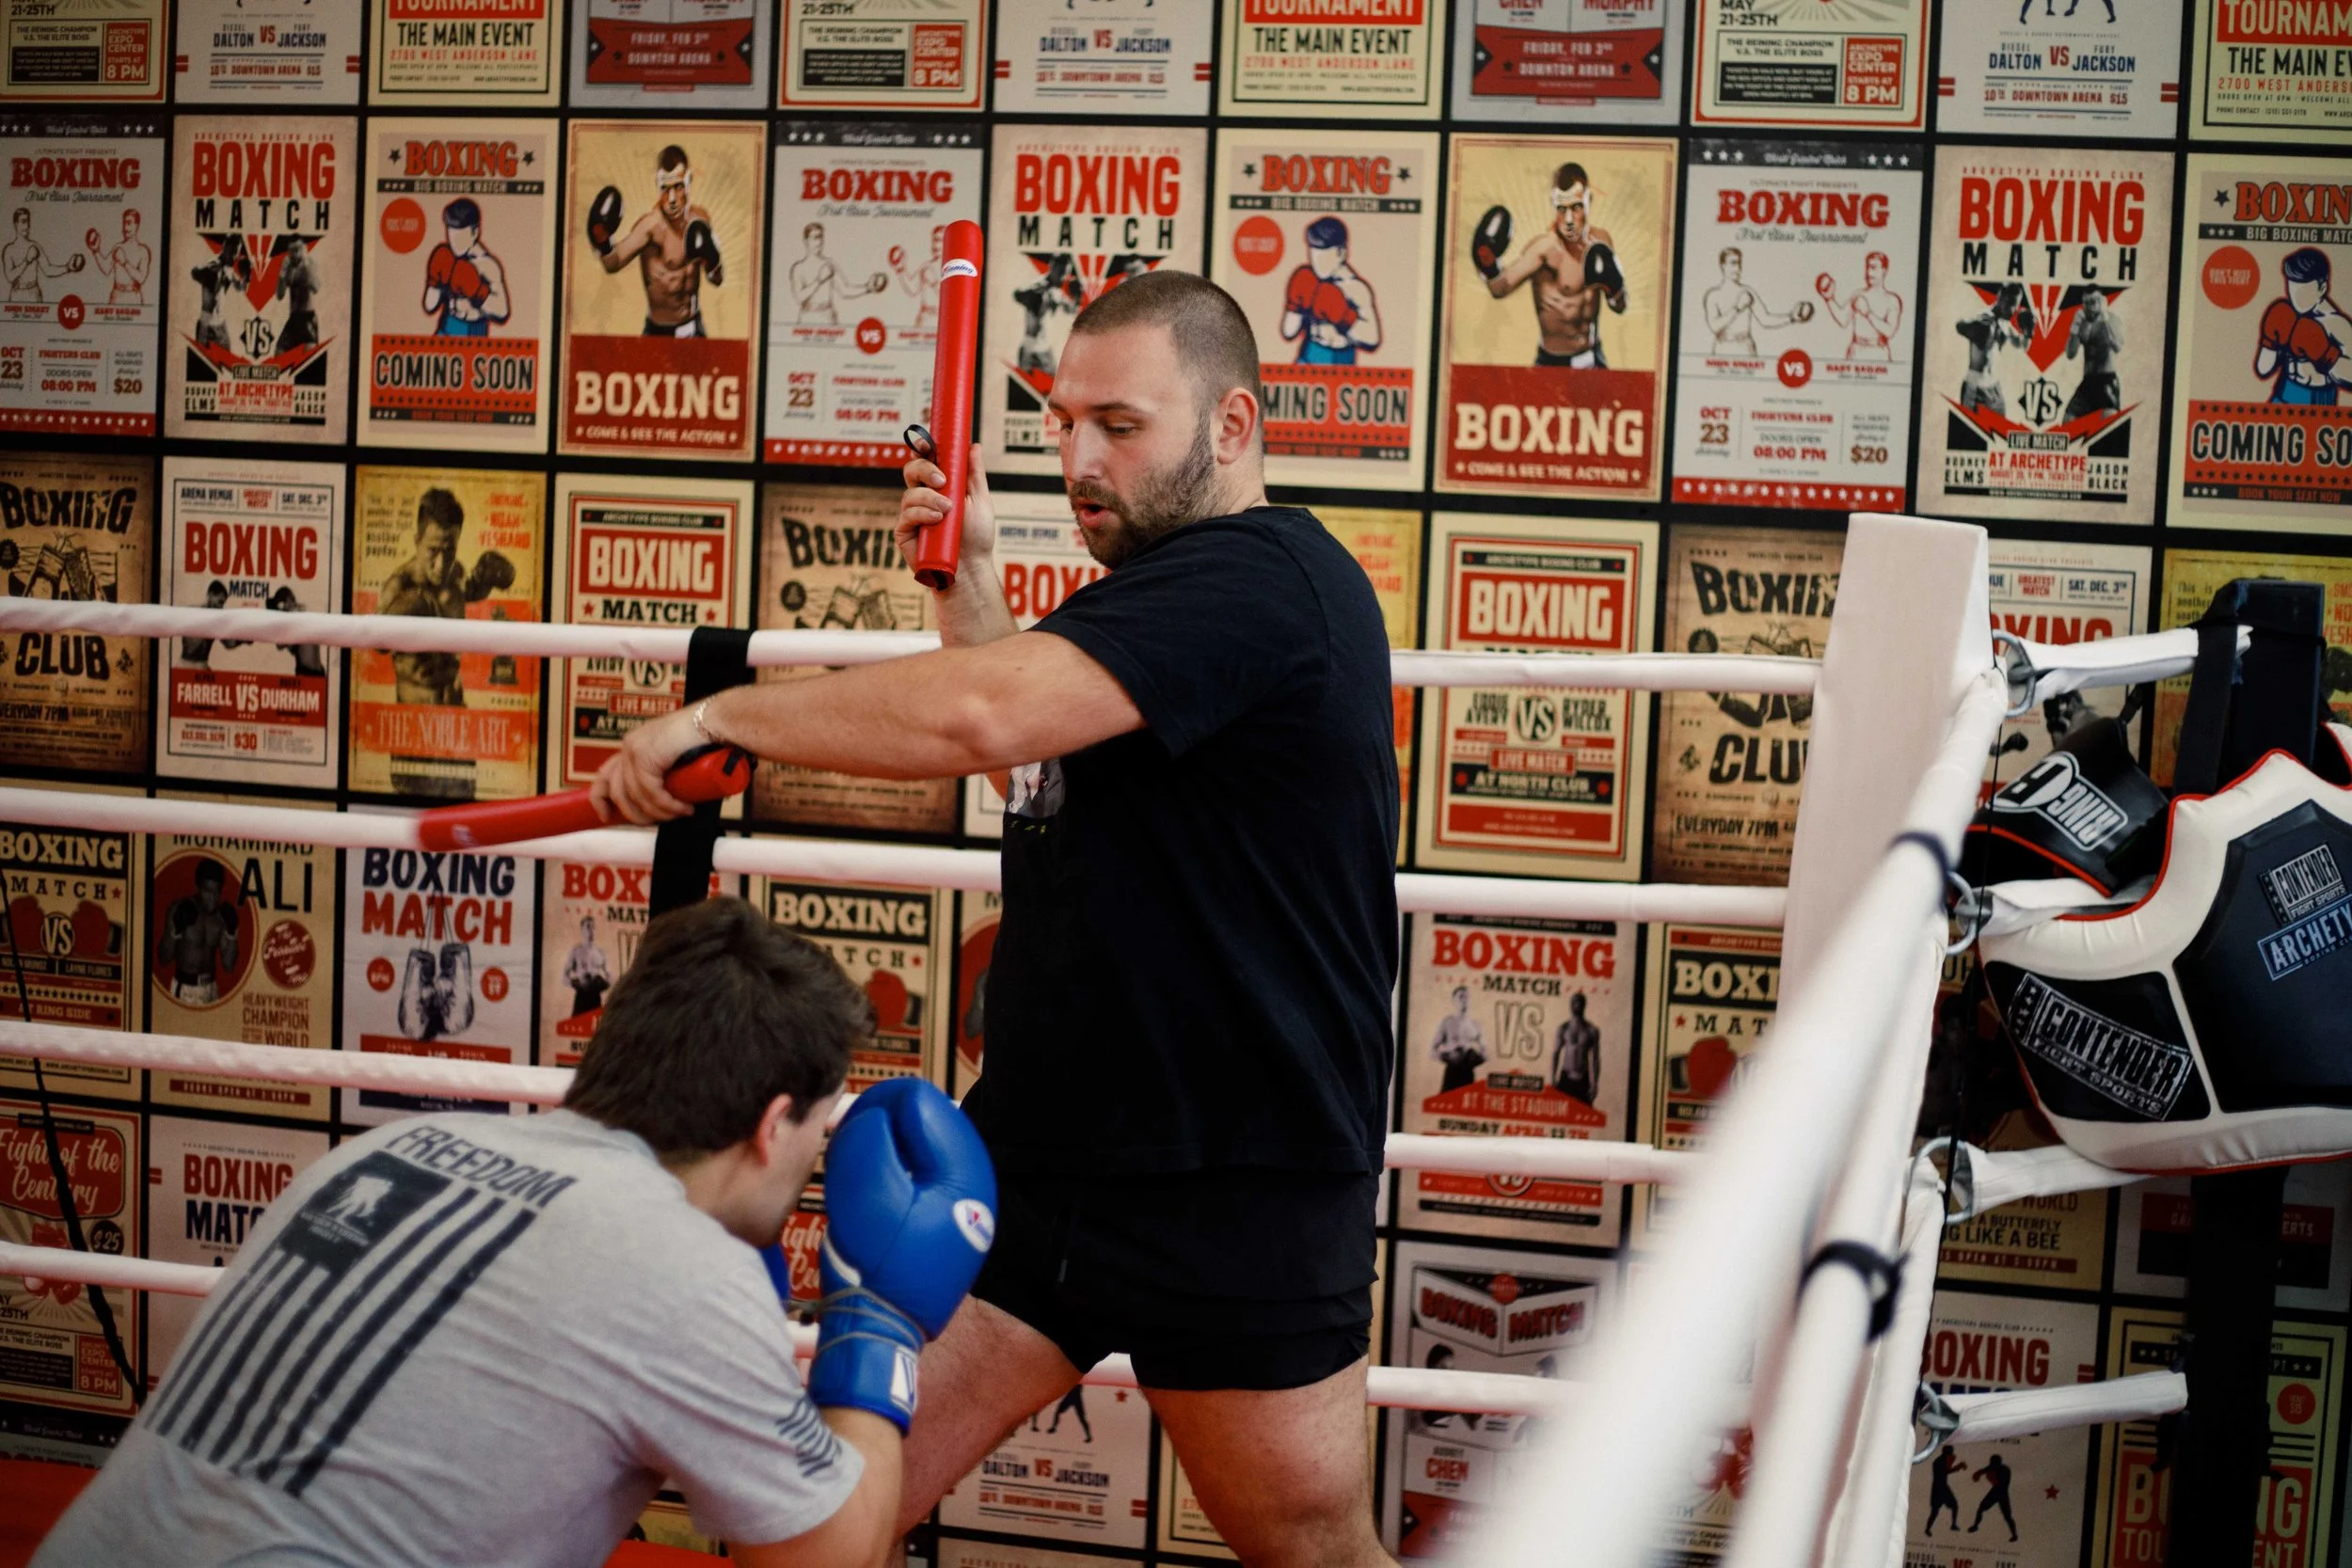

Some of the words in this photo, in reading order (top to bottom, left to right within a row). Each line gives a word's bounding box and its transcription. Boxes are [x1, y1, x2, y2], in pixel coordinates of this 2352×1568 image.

[1720, 0, 1755, 12] MAY
[1720, 12, 1778, 26] 21-25TH
[2224, 0, 2352, 36] TOURNAM
[213, 32, 254, 47] DALTON
[260, 24, 276, 43] VS
[278, 32, 326, 48] JACKSON
[398, 23, 430, 46] THE
[433, 23, 477, 47] MAIN
[481, 23, 534, 47] EVENT
[1253, 28, 1288, 53] THE
[1295, 28, 1344, 54] MAIN
[1351, 29, 1411, 55] EVENT
[1848, 61, 1897, 73] CENTER
[1849, 52, 1883, 62] EXPO
[1989, 53, 2042, 70] DALTON
[2049, 45, 2070, 67] VS
[2073, 55, 2136, 72] JACKSON
[2228, 47, 2266, 74] THE
[2273, 48, 2328, 77] MAIN
[1846, 86, 1859, 101] 8
[1865, 87, 1897, 103] PM
[2011, 90, 2069, 103] DOWNTOWN
[2072, 91, 2103, 103] ARENA
[2217, 77, 2250, 90] 2700
[2257, 78, 2291, 91] WEST
[2297, 79, 2352, 94] ANDERS
[192, 141, 336, 199] BOXING
[405, 138, 518, 178] BOXING
[11, 157, 140, 189] BOXING
[802, 169, 954, 204] BOXING
[1015, 153, 1181, 216] BOXING
[1261, 154, 1392, 196] BOXING
[196, 199, 330, 230] MATCH
[1716, 189, 1890, 229] BOXING
[1959, 177, 2145, 245] BOXING
[2233, 181, 2352, 226] BOXIN
[1019, 215, 1175, 250] MATCH
[2247, 227, 2266, 241] BIG
[2273, 228, 2318, 242] BOXING
[2323, 229, 2352, 243] MATC
[1963, 242, 2137, 282] MATCH
[63, 307, 79, 319] VS
[245, 321, 272, 356] VS
[2, 361, 24, 379] 23
[375, 352, 463, 390] COMING
[472, 355, 535, 393] SOON
[1784, 361, 1805, 377] VS
[114, 379, 142, 394] $20
[218, 384, 232, 396] AT
[235, 384, 294, 400] ARCHETYPE
[574, 371, 740, 421] BOXING
[1263, 382, 1329, 422] MING
[1337, 383, 1410, 426] SOON
[1700, 406, 1731, 420] OCT
[2025, 380, 2060, 421] VS
[1454, 403, 1645, 458] BOXING
[1701, 423, 1730, 445] 23
[2010, 434, 2030, 448] LIVE
[2033, 435, 2068, 450] MATCH
[1754, 445, 1798, 460] 08:00
[1800, 447, 1827, 462] PM
[1851, 444, 1889, 466] $20
[2191, 420, 2306, 467] COMING
[2316, 425, 2352, 469] SO
[1468, 461, 1505, 475] COME
[1519, 463, 1543, 479] SEE
[1546, 464, 1573, 480] THE
[1989, 452, 2006, 467] AT
[2010, 453, 2087, 471] ARCHETYPE
[2088, 463, 2128, 475] JASON
[1946, 469, 1985, 485] ELMS
[2088, 478, 2128, 490] BLACK
[0, 481, 136, 534] BOXING
[2238, 487, 2265, 499] BOOK
[2296, 490, 2317, 502] SEAT
[2320, 491, 2342, 503] NOW
[184, 522, 318, 580] BOXING
[588, 535, 715, 594] BOXING
[229, 579, 269, 598] MATCH
[2017, 574, 2056, 586] GREATEST
[2022, 585, 2050, 598] MATCH
[2068, 578, 2088, 592] SAT.
[2089, 579, 2110, 593] DEC.
[601, 598, 697, 625] MATCH
[1468, 578, 1613, 642] BOXING
[15, 631, 110, 680] CLUB
[177, 682, 232, 707] FARRELL
[236, 683, 259, 714] VS
[262, 690, 320, 713] DURHAM
[1562, 698, 1607, 716] RYDER
[45, 706, 69, 722] 7PM
[1465, 707, 1509, 724] AVERY
[1517, 698, 1556, 741] VS
[234, 732, 257, 752] $30
[378, 709, 412, 749] THE
[417, 712, 474, 752] NOBLE
[478, 718, 512, 753] ART
[1499, 752, 1526, 770] LIVE
[1528, 753, 1568, 773] MATCH
[1708, 733, 1810, 784] CLU
[1474, 773, 1497, 789] AT
[1500, 774, 1547, 792] NORTH
[1550, 777, 1590, 794] CLUB
[1677, 815, 1743, 837] EVERYDAY
[1748, 816, 1778, 838] 7PM
[0, 831, 123, 870] BOXING
[237, 857, 313, 914] ALI
[362, 847, 516, 897] BOXING
[563, 863, 651, 905] BOX
[2275, 845, 2343, 908] CONTENDER
[11, 877, 107, 900] MATCH
[774, 891, 928, 937] BOXING
[2292, 899, 2316, 920] FIGHT
[2316, 885, 2347, 906] SPORTS
[361, 890, 513, 945] MATCH
[44, 916, 72, 957] VS
[2270, 908, 2352, 973] ARCHETY
[1432, 929, 1617, 979] BOXING
[1482, 974, 1562, 997] MATCH
[1674, 959, 1780, 1002] BOXI
[37, 1005, 64, 1018] RING
[66, 1007, 92, 1021] SIDE
[242, 992, 310, 1009] HEAVYWEIGHT
[242, 1010, 310, 1032] CHAMPION
[1494, 1000, 1546, 1063] VS
[2039, 1000, 2188, 1106] CONTENDER
[1461, 1092, 1479, 1110] AT
[1483, 1095, 1507, 1113] THE
[1510, 1097, 1569, 1117] STADIUM
[2089, 1070, 2165, 1116] SPORTS
[1438, 1119, 1501, 1134] SUNDAY
[87, 1132, 119, 1175] the
[384, 1124, 580, 1210] FREEDOM
[1991, 1214, 2062, 1232] BUTTERFLY
[93, 1227, 120, 1253] $25
[1965, 1226, 2004, 1245] LIKE
[2009, 1229, 2021, 1248] A
[2026, 1231, 2061, 1251] BEE
[1419, 1285, 1500, 1339] BOXING
[1507, 1299, 1586, 1343] MATCH
[1034, 1458, 1053, 1479] VS
[1055, 1468, 1111, 1489] JACKSON
[1424, 1457, 1470, 1483] CHEN
